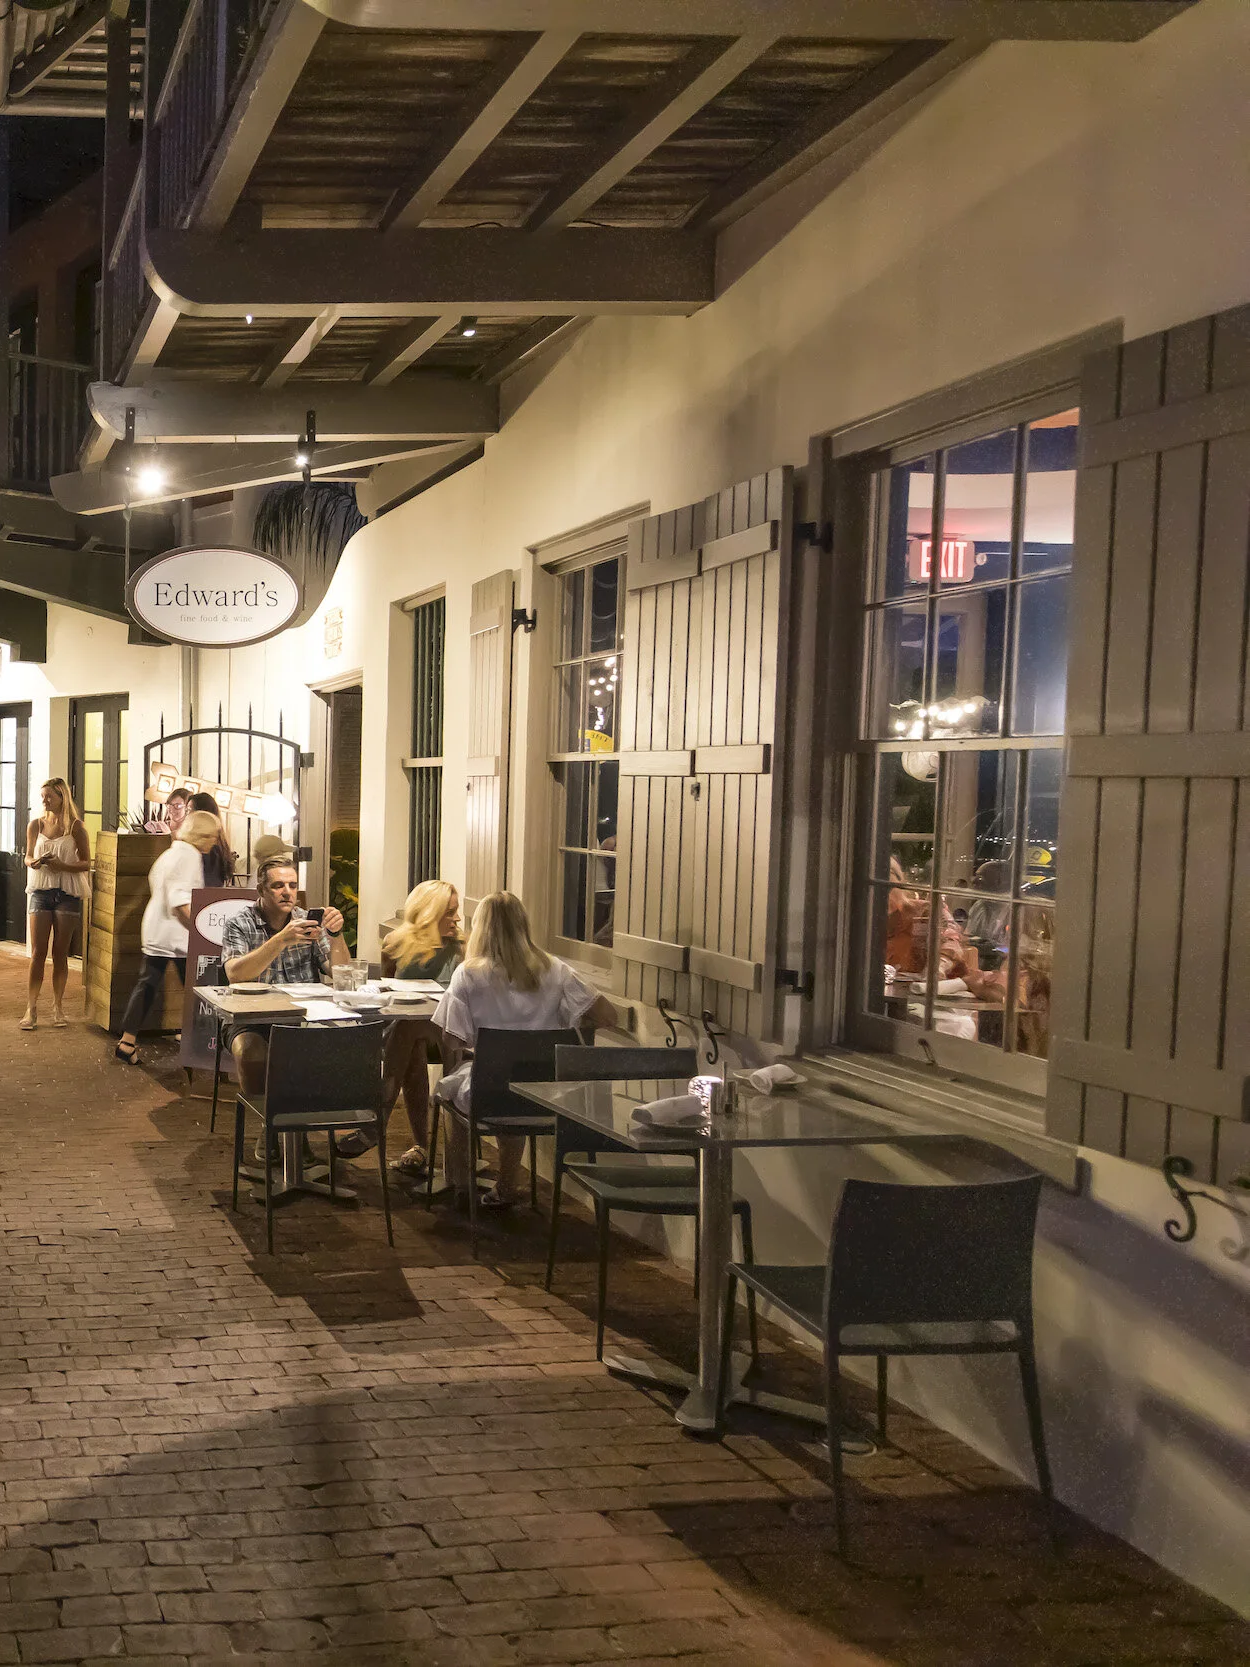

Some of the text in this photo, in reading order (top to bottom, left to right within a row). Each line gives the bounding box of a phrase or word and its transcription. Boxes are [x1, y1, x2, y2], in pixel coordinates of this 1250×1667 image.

[920, 541, 968, 578] EXIT
[154, 581, 279, 607] Edward's
[180, 614, 253, 623] fine food & wine
